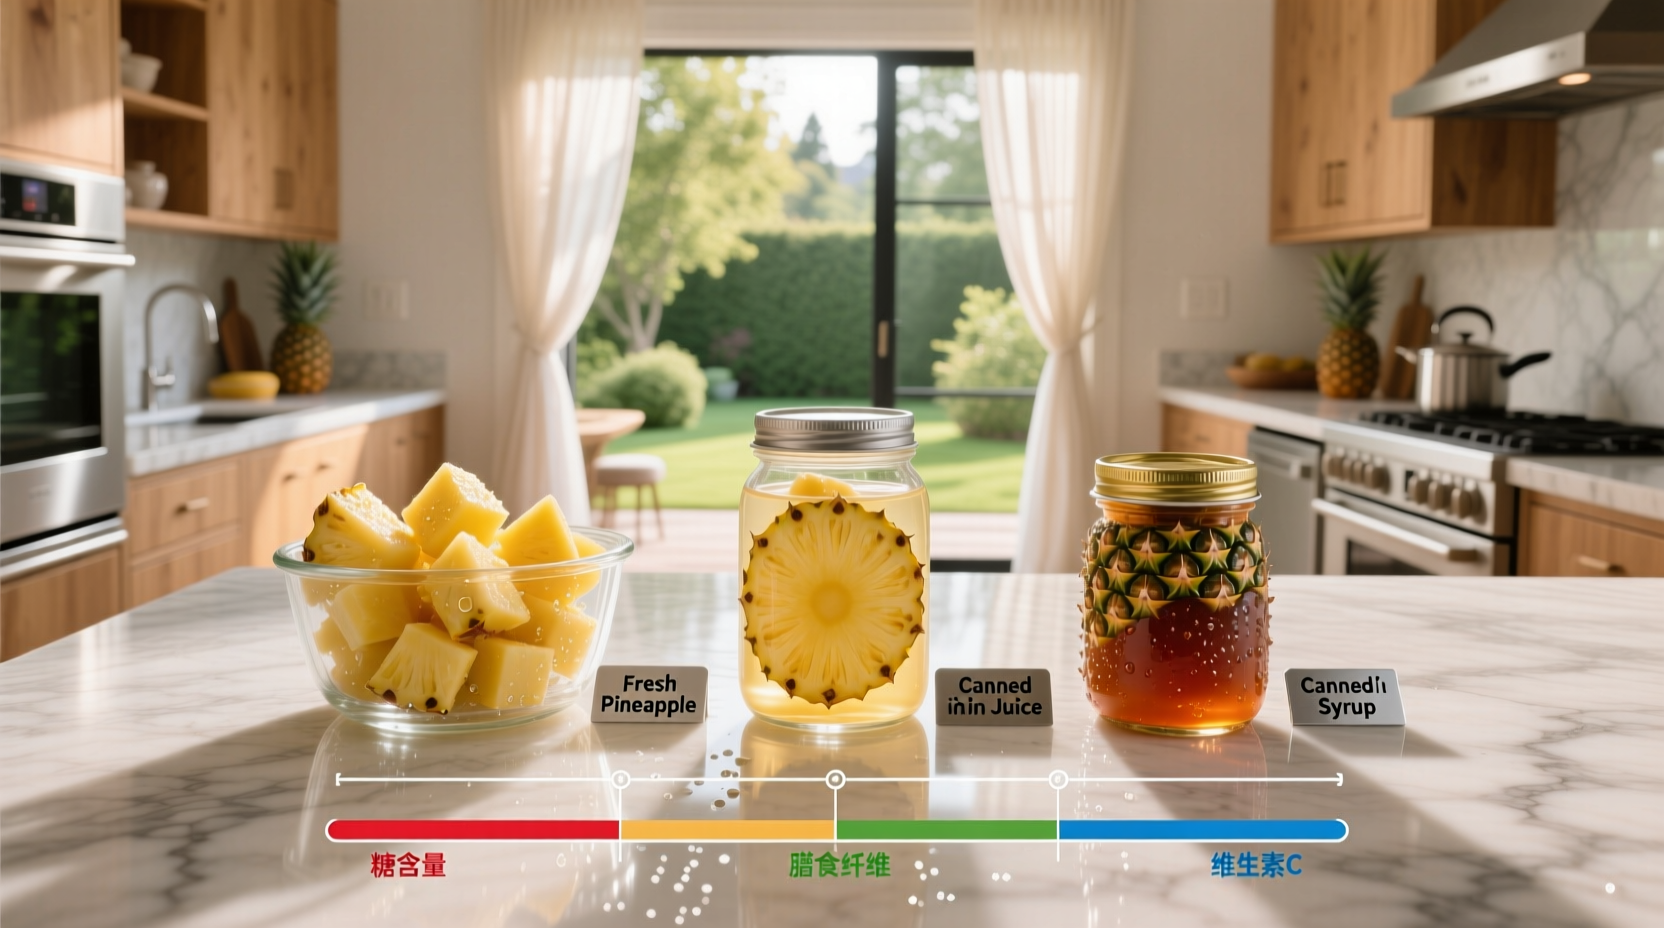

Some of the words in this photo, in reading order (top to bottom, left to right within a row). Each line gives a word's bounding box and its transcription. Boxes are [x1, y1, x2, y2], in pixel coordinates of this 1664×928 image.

[623, 674, 677, 692] Fresh
[959, 676, 1032, 694] Canned
[601, 695, 697, 718] Pineapple
[991, 698, 1043, 715] Juice
[1318, 697, 1377, 720] Syrup
